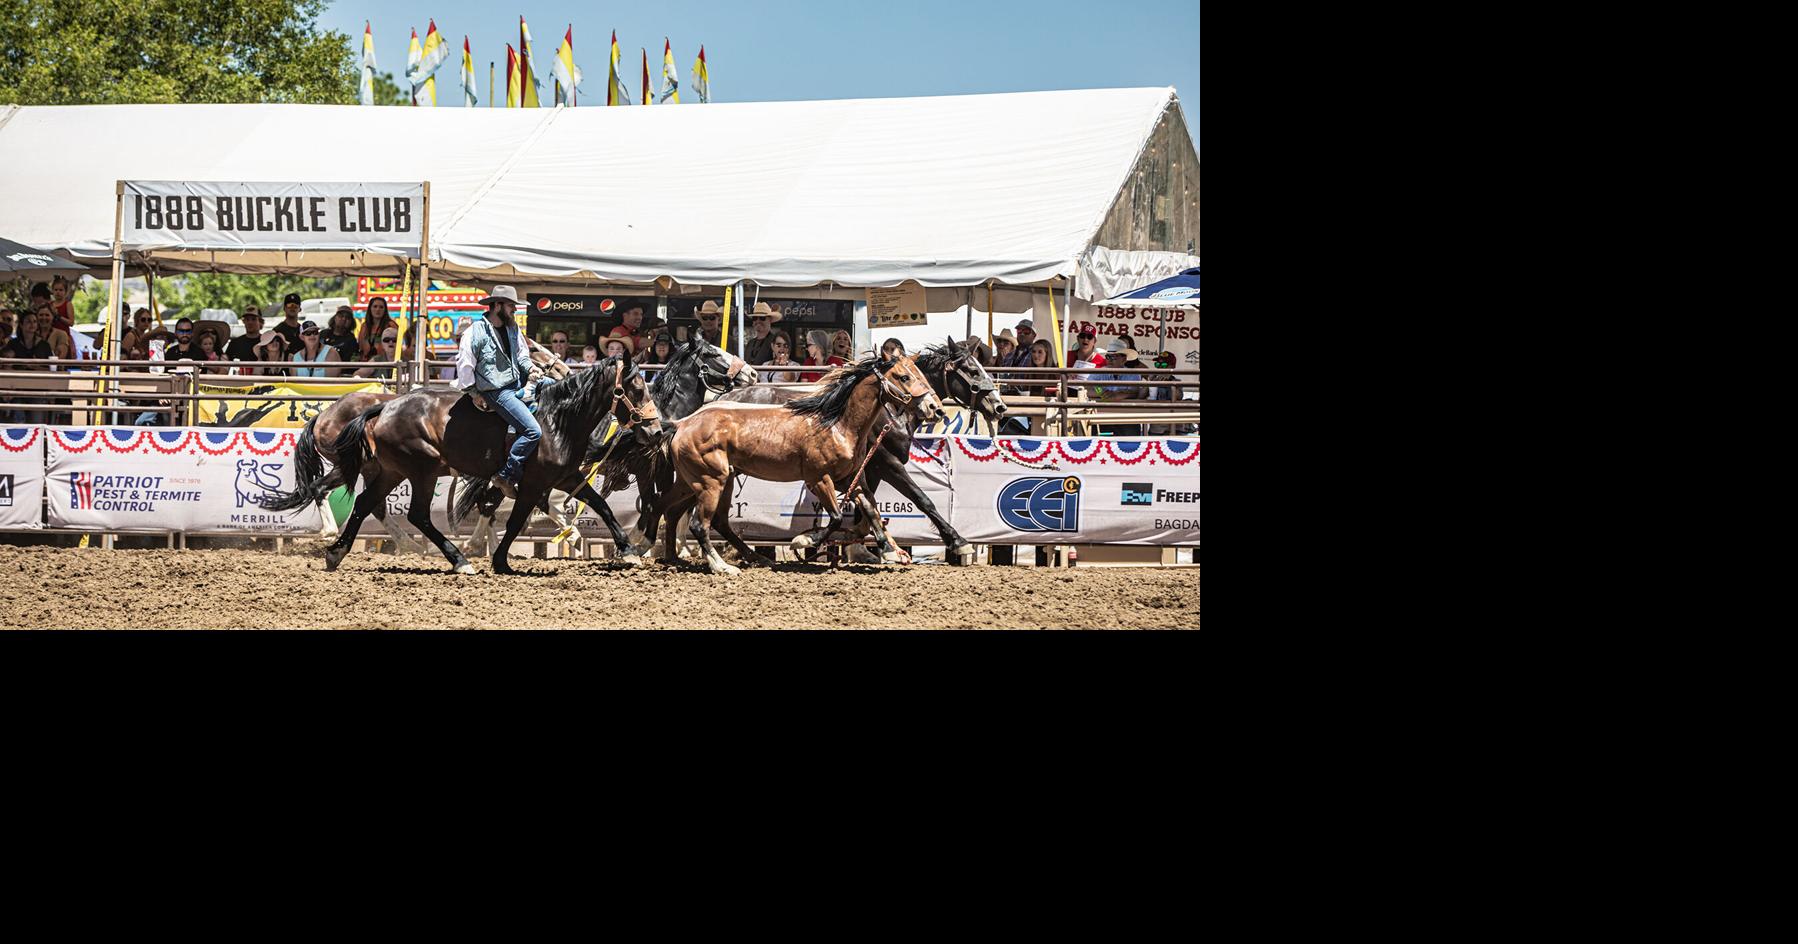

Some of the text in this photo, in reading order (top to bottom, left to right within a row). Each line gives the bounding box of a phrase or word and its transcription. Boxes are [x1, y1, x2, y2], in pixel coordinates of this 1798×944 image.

[134, 195, 411, 233] 1888 BUCKLE CLUB
[553, 301, 583, 311] pepsi
[784, 303, 816, 316] pepsi
[1097, 306, 1185, 323] 1888 CLUB
[1095, 321, 1129, 336] TAB
[93, 475, 163, 489] PATRIOT
[94, 488, 202, 502] PEST & TERMITE
[93, 500, 155, 512] CONTROL
[893, 502, 914, 513] GAS
[230, 514, 286, 524] MERRILL
[1154, 519, 1200, 530] BAGDA
